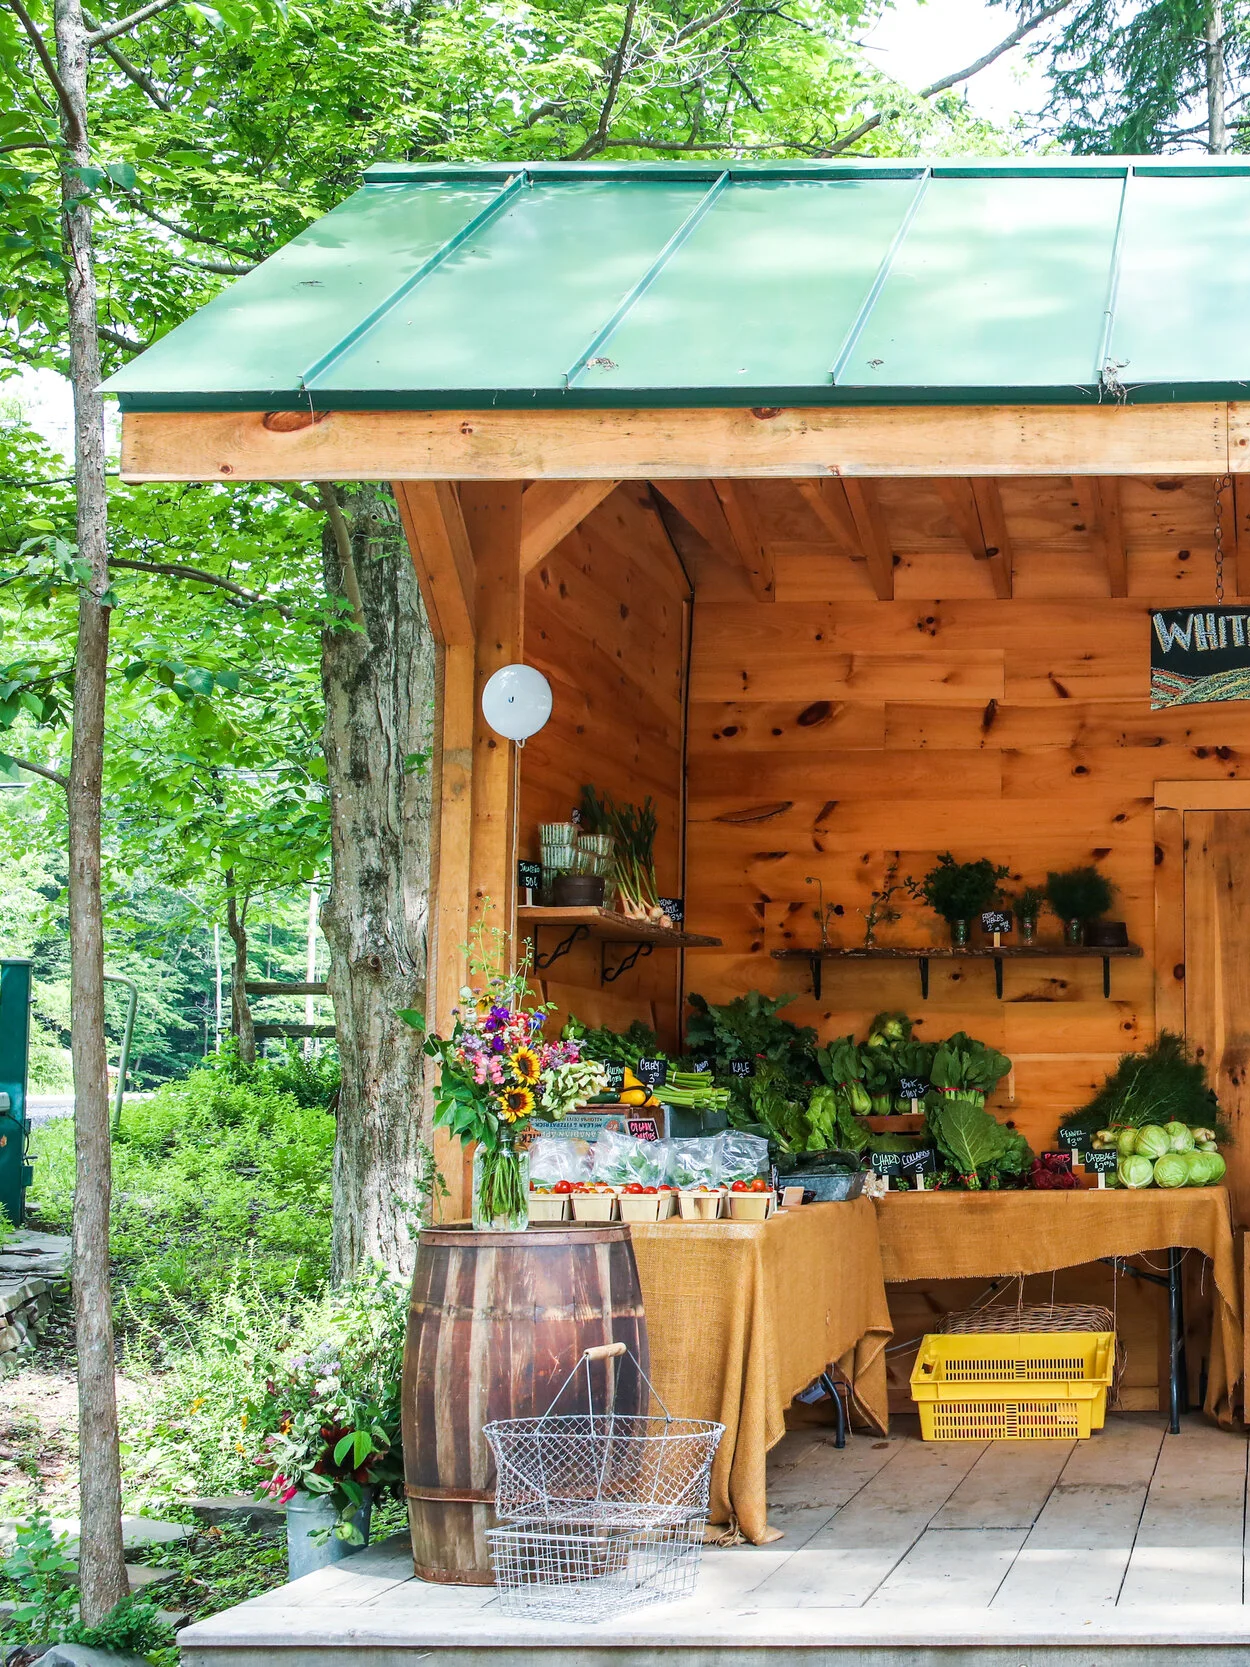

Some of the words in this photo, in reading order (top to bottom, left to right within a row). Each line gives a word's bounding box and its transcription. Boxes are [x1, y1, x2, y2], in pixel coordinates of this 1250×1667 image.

[732, 1061, 750, 1073] KALE
[872, 1153, 900, 1167] CHARD
[1085, 1151, 1117, 1163] CABBAGE
